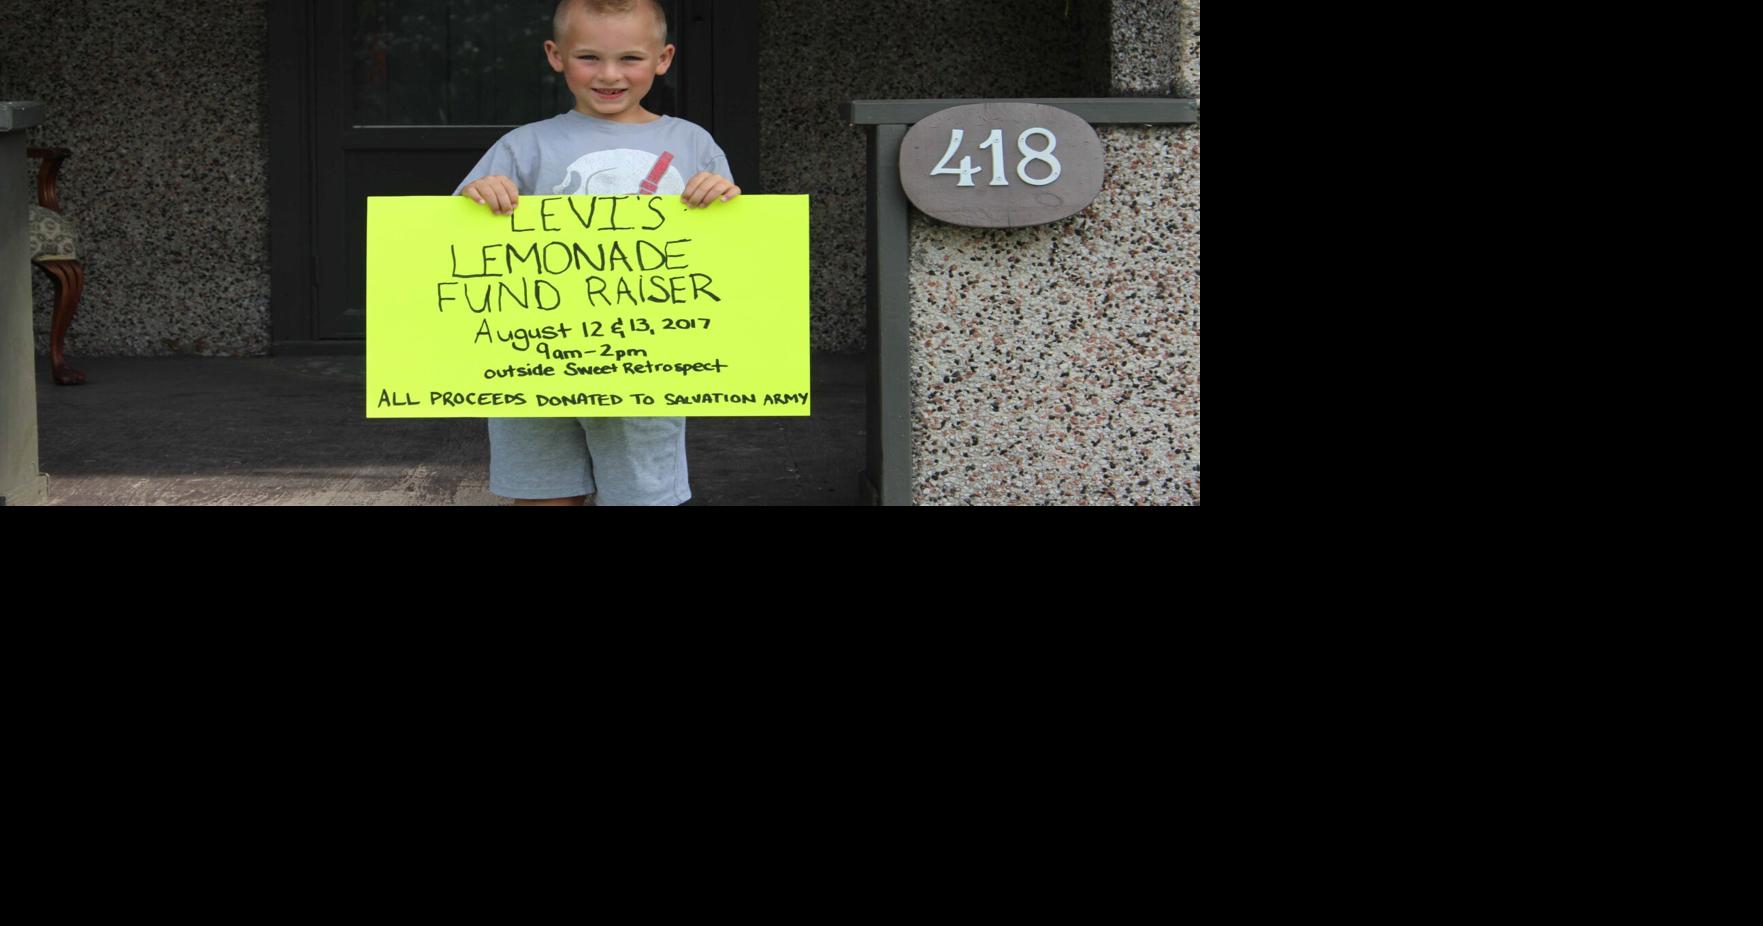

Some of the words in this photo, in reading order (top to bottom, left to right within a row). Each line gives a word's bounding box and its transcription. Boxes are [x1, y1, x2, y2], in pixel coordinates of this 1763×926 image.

[930, 127, 1061, 187] 418
[451, 238, 691, 279] LEMONADE
[437, 277, 561, 313] FUND
[474, 318, 572, 352] August
[582, 321, 604, 338] 12
[662, 318, 711, 332] 2017
[484, 363, 556, 379] outside
[563, 362, 619, 376] Sweet
[622, 358, 727, 376] Retrospect
[378, 389, 420, 407] ALL
[430, 391, 527, 407] PROCEEDS
[535, 392, 623, 407] DONATED
[630, 393, 655, 406] TO
[664, 393, 756, 406] SALVATION
[763, 392, 810, 406] ARMY
